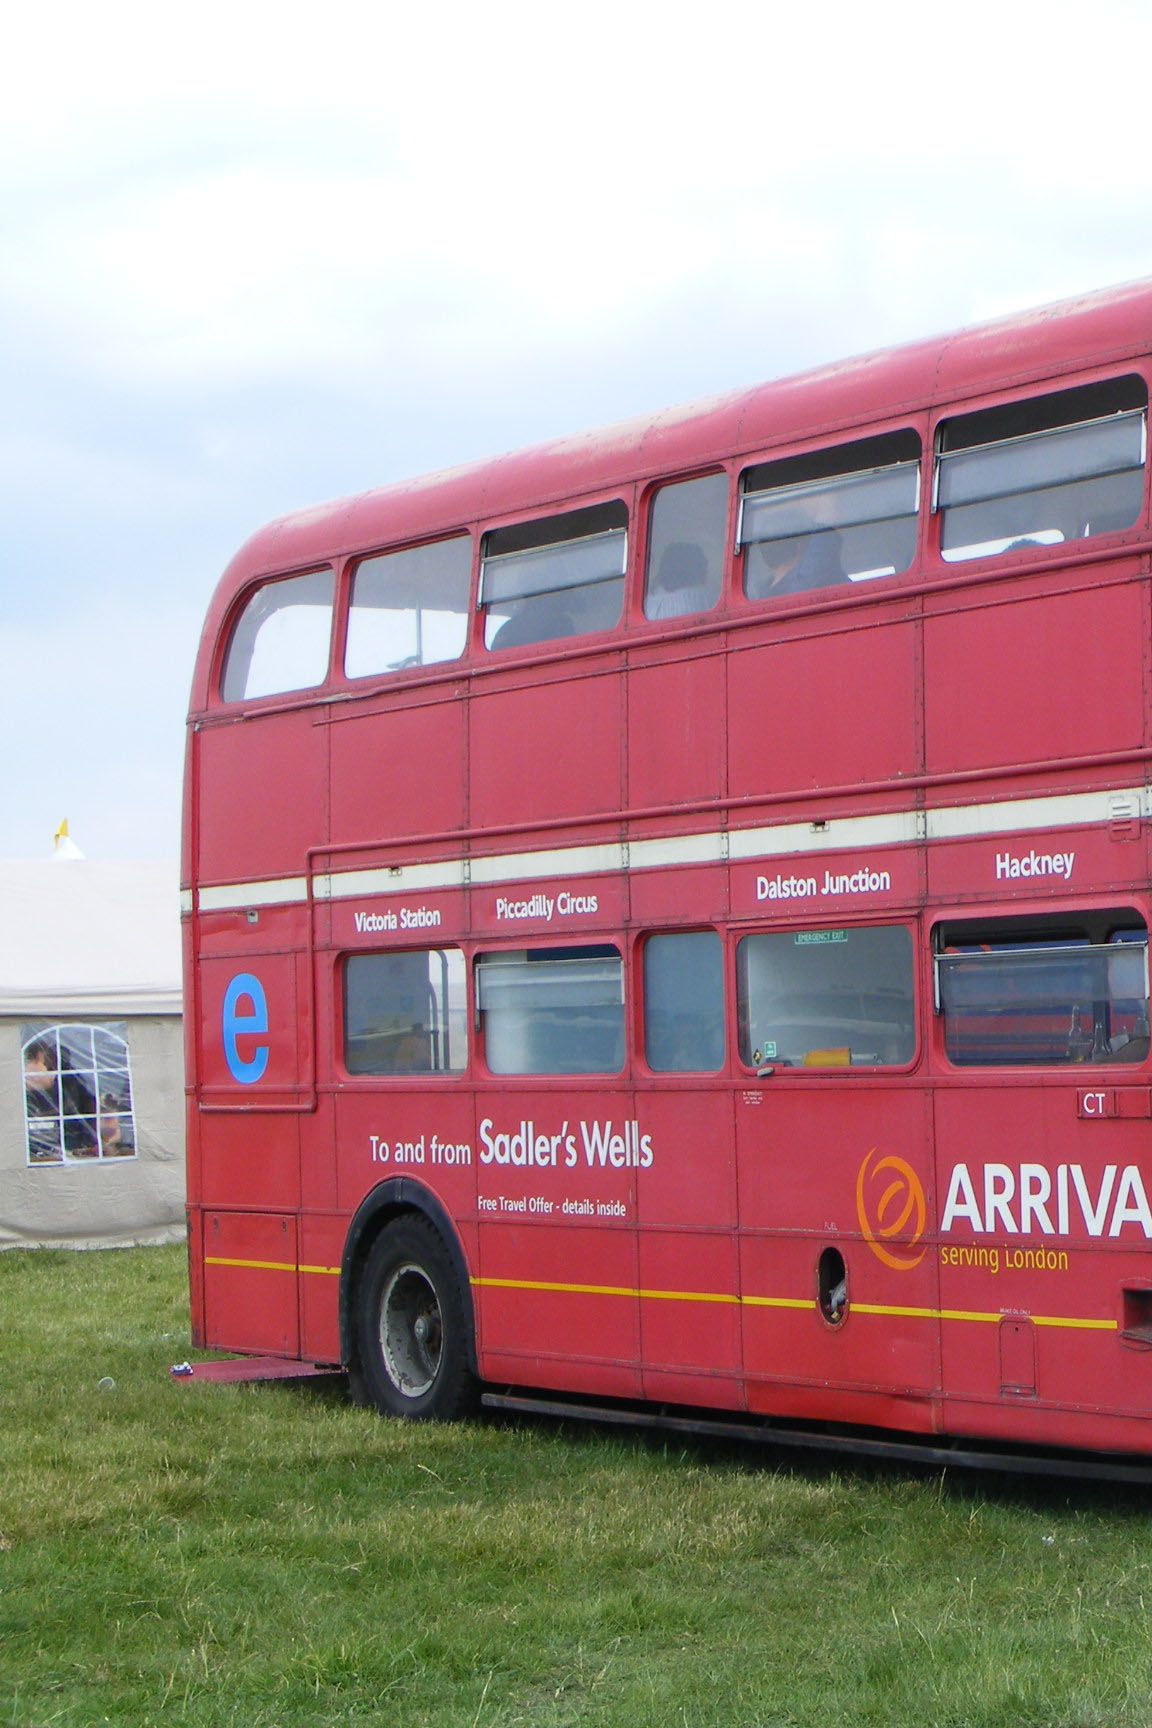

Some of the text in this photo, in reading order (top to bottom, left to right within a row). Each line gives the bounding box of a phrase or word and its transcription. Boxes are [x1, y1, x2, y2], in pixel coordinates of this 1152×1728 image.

[996, 850, 1075, 880] Hackney
[757, 867, 890, 900] Dalston Junction
[354, 906, 441, 932] Victoria Station
[496, 892, 598, 921] Piccadilly Circus
[798, 930, 845, 942] EMERGENCY EXIT
[1083, 1092, 1106, 1114] CT
[369, 1135, 472, 1165] To and from
[479, 1118, 654, 1168] Sadler's Wells
[477, 1195, 497, 1212] Free
[499, 1196, 527, 1213] Travel
[529, 1197, 554, 1214] Offer
[562, 1199, 594, 1215] details
[597, 1201, 626, 1217] inside
[941, 1242, 1069, 1273] serving London
